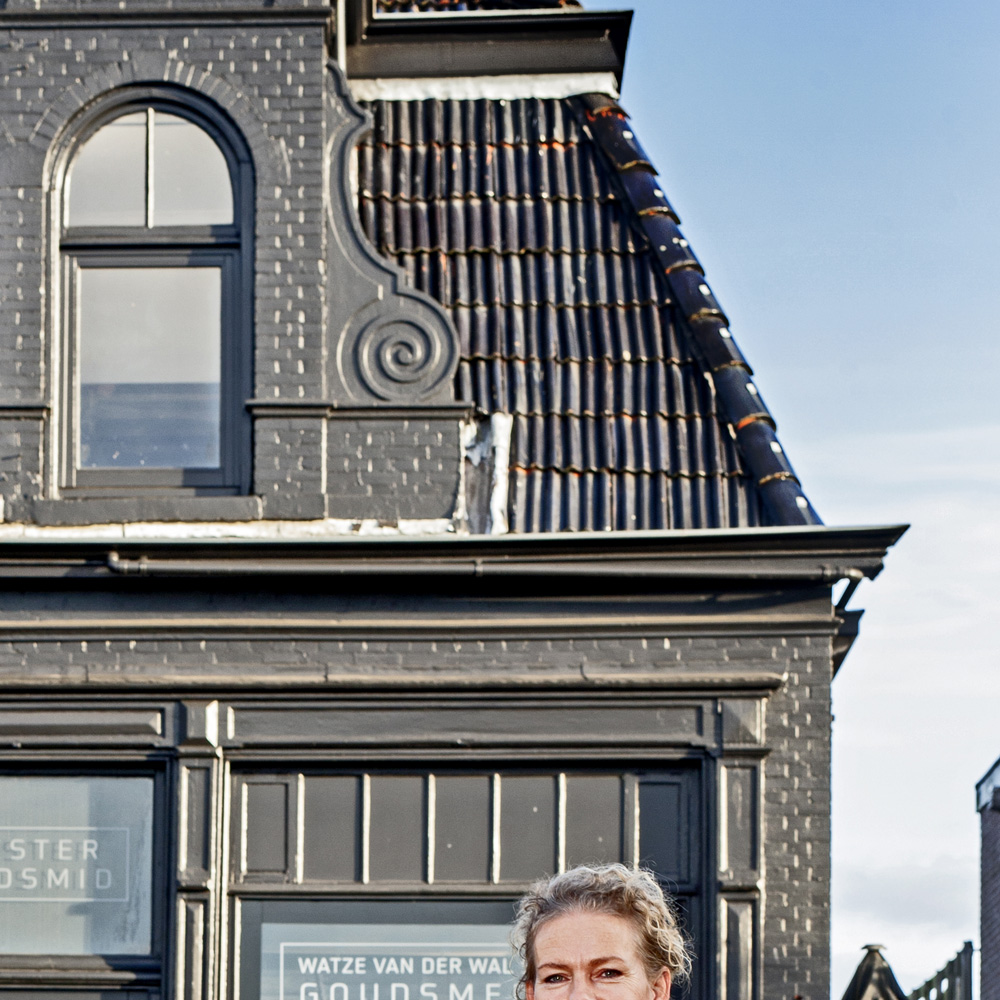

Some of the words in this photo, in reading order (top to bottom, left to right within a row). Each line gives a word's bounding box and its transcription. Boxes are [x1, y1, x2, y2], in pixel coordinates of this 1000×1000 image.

[297, 956, 367, 975] WATZE
[372, 957, 414, 975] VAN
[421, 957, 463, 975] DER
[468, 957, 514, 976] WAL
